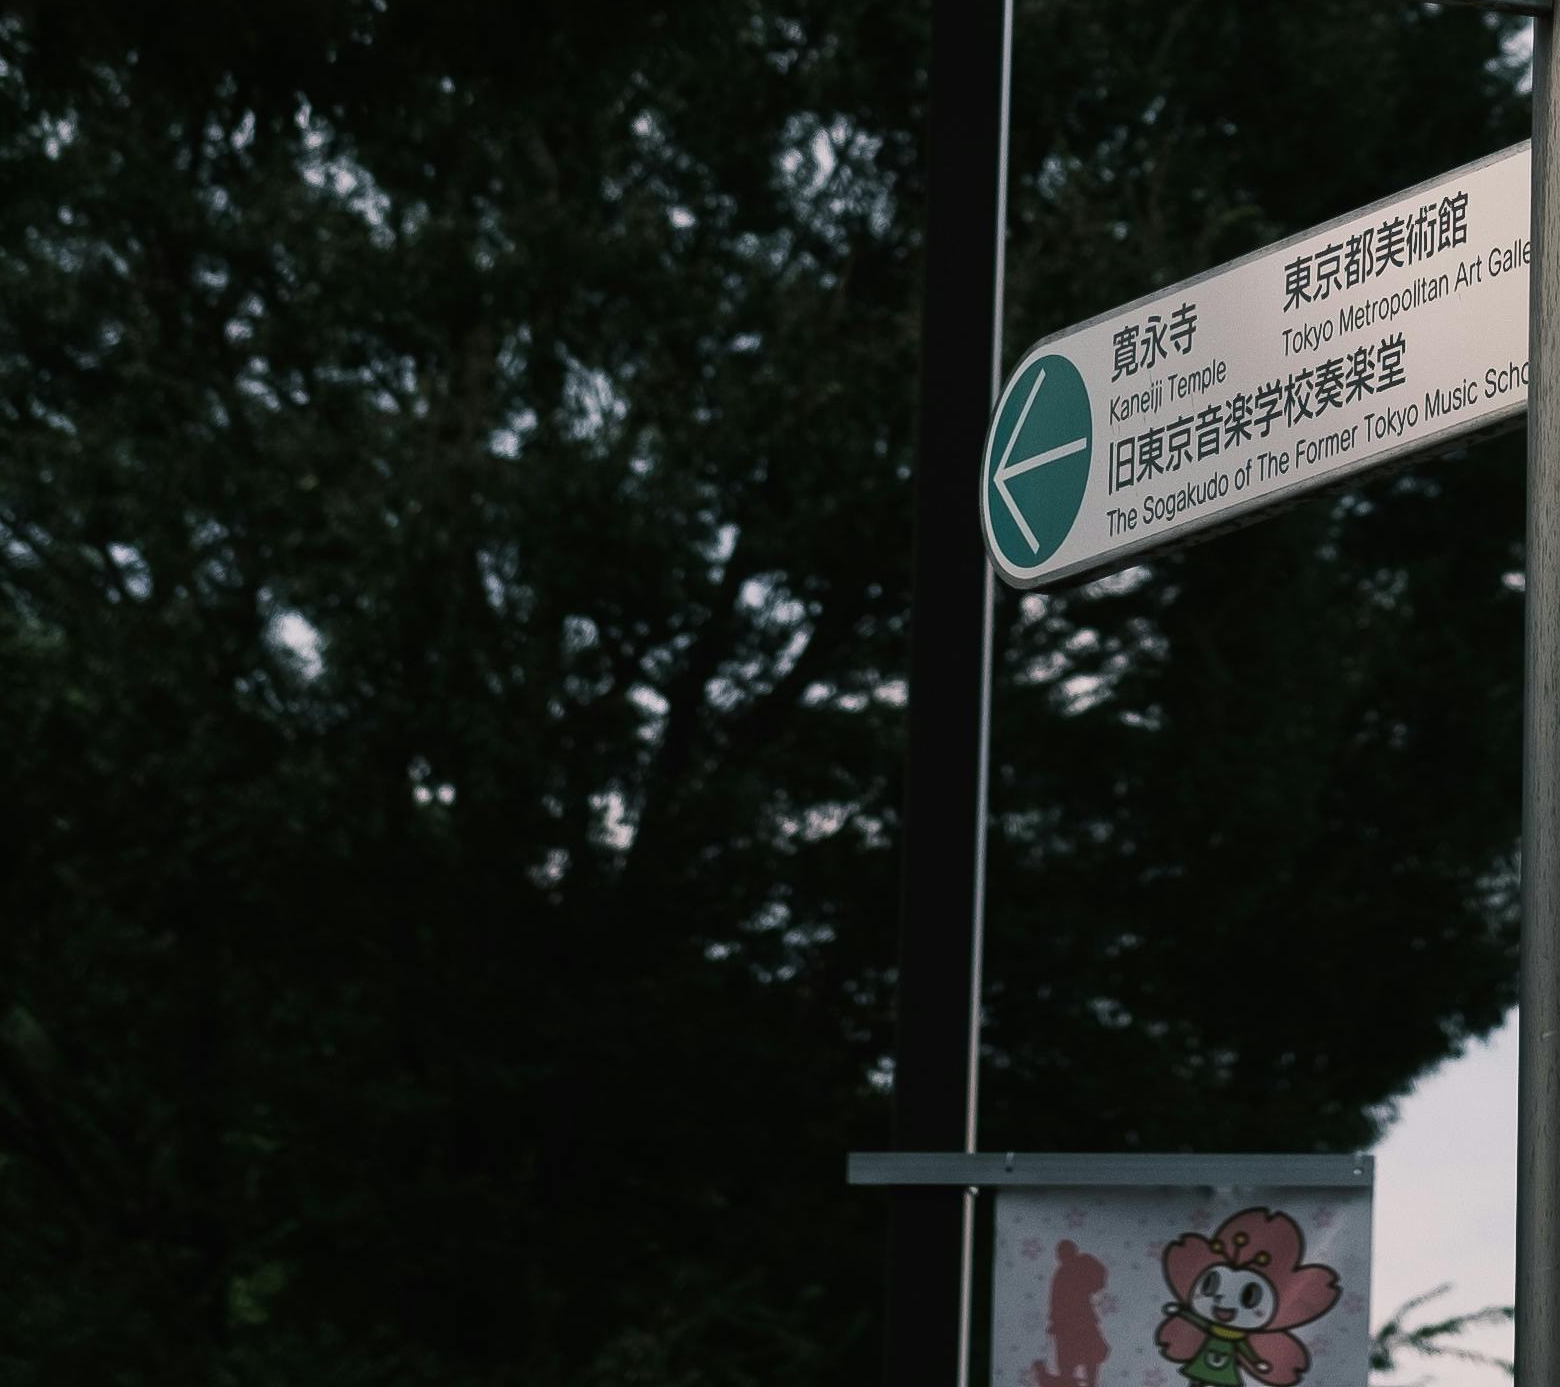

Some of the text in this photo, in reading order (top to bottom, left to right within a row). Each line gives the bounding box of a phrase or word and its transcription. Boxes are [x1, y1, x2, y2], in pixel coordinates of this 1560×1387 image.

[1282, 319, 1334, 356] Tokyo
[1339, 274, 1449, 336] Metropolitan
[1454, 255, 1482, 292] Art
[1283, 191, 1468, 313] 東京都美術館
[1109, 359, 1227, 425] Kaneiji Temple
[1111, 303, 1198, 383] 寛永寺
[1106, 507, 1137, 537] The
[1142, 472, 1229, 525] Sogakudo
[1234, 458, 1252, 490] of
[1257, 451, 1289, 481] The
[1295, 426, 1358, 468] Former
[1364, 404, 1419, 442] Tokyo
[1424, 379, 1478, 421] Music
[1108, 332, 1406, 496] 旧東京音楽学校奏楽堂
